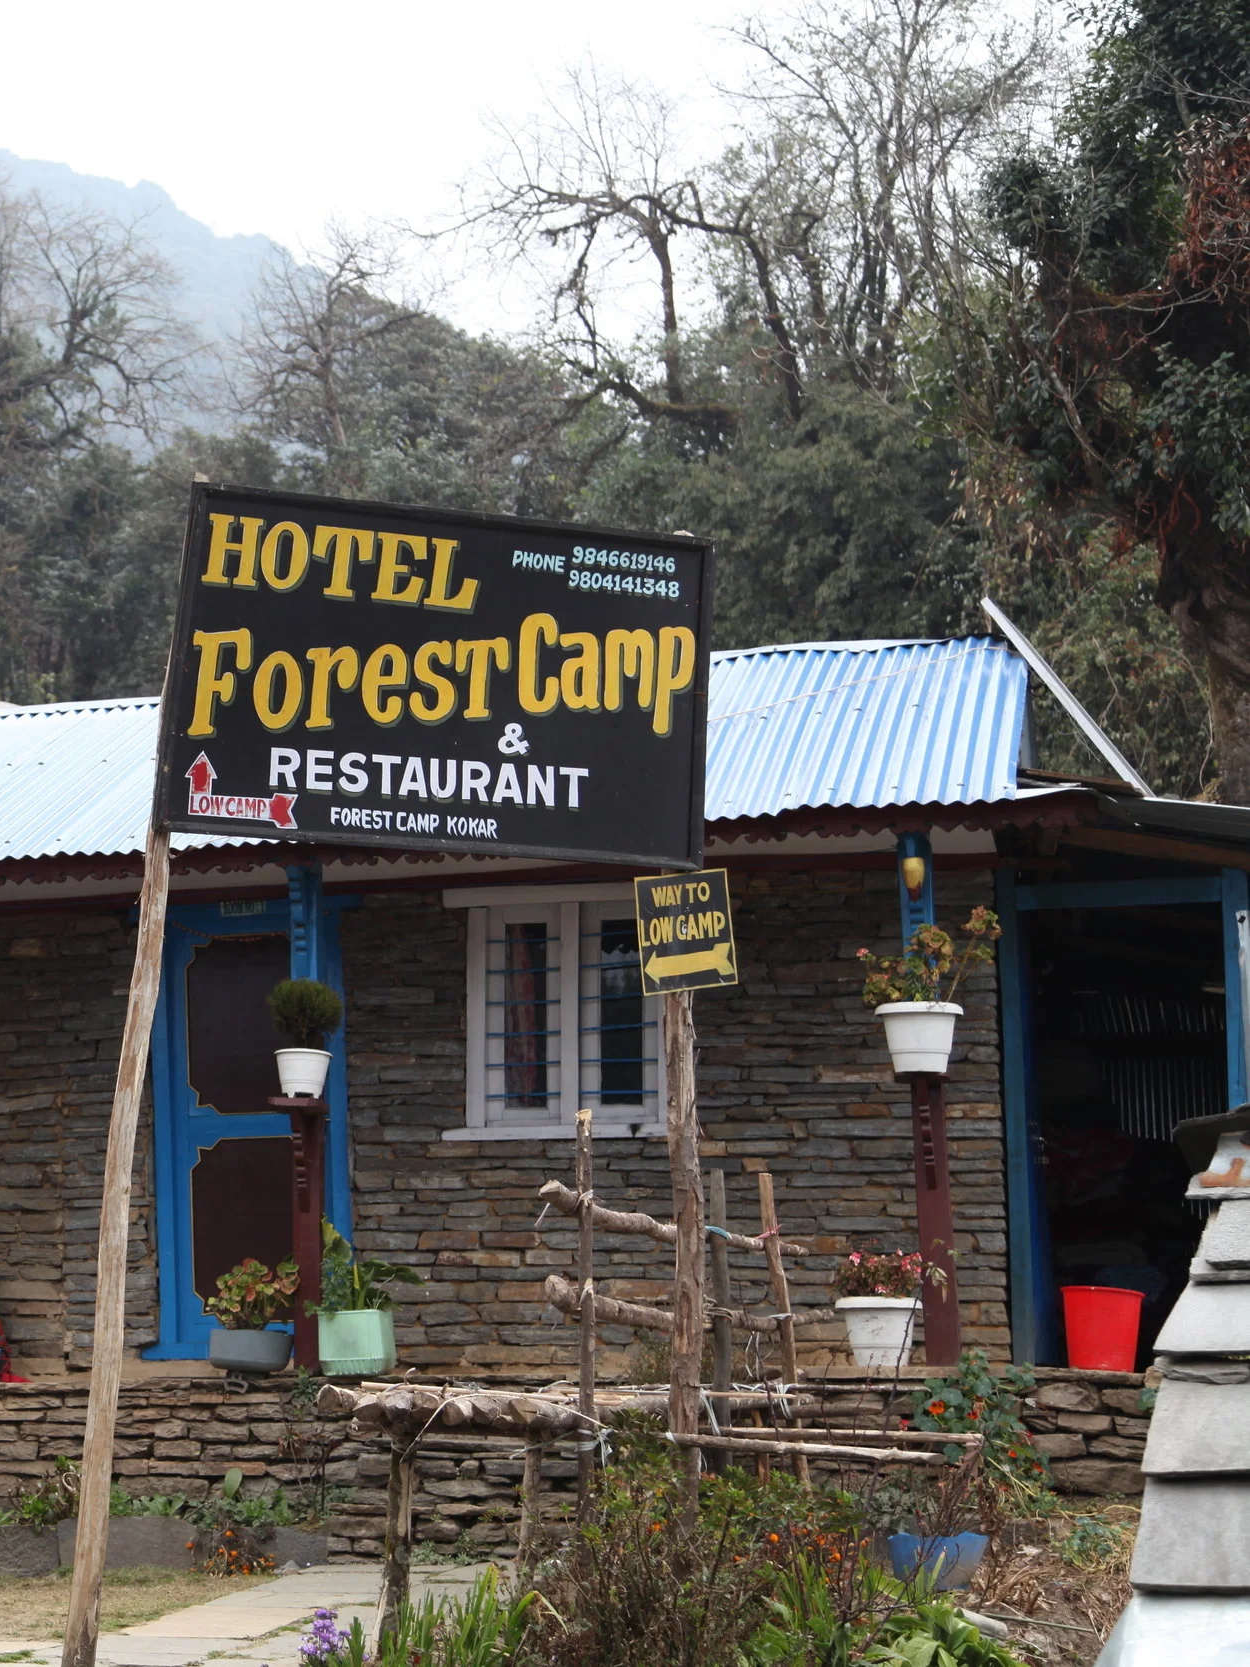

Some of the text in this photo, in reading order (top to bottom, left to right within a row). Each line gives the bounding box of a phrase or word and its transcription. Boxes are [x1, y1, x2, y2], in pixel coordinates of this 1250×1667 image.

[201, 512, 480, 611] HOTEL
[512, 545, 676, 573] PHONE 9846619146
[568, 569, 680, 598] 9804141348
[518, 613, 695, 735] Camp
[498, 723, 529, 755] &
[269, 747, 589, 808] RESTAURANT
[190, 796, 266, 818] LOW CAMP
[331, 807, 498, 840] FOREST CAMP KOKAR
[651, 881, 711, 908] WAY TO
[640, 911, 726, 947] LOW CAMP
